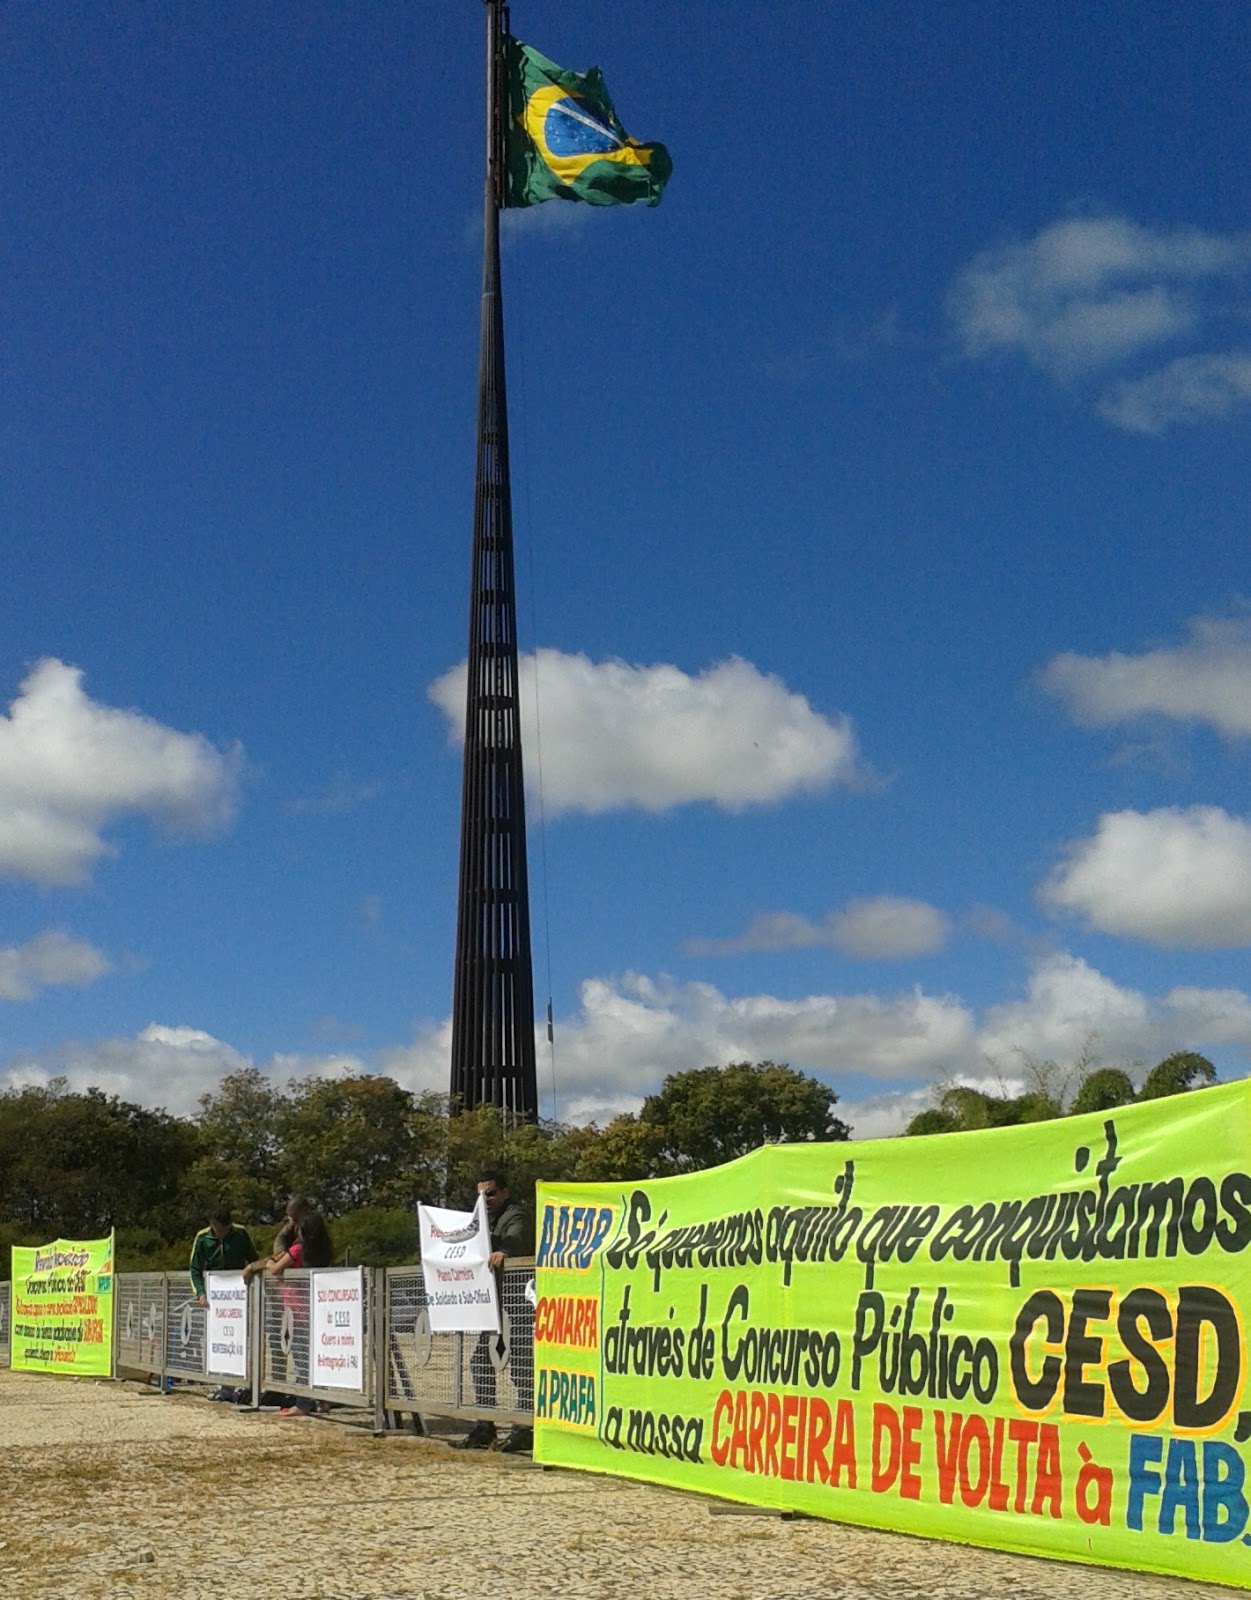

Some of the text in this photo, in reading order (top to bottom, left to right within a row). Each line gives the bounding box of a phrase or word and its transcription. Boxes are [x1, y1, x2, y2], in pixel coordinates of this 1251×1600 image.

[606, 1119, 1251, 1292] Só queremos aquilo que conquistamos
[535, 1296, 599, 1349] CONARFA
[604, 1285, 684, 1379] através
[687, 1284, 715, 1380] de
[721, 1284, 841, 1388] Concurso
[850, 1286, 999, 1405] Público
[604, 1405, 629, 1452] a
[628, 1409, 704, 1465] nossa
[711, 1388, 858, 1490] CARREIRA
[871, 1402, 924, 1501] DE
[934, 1409, 1063, 1519] VOLTA
